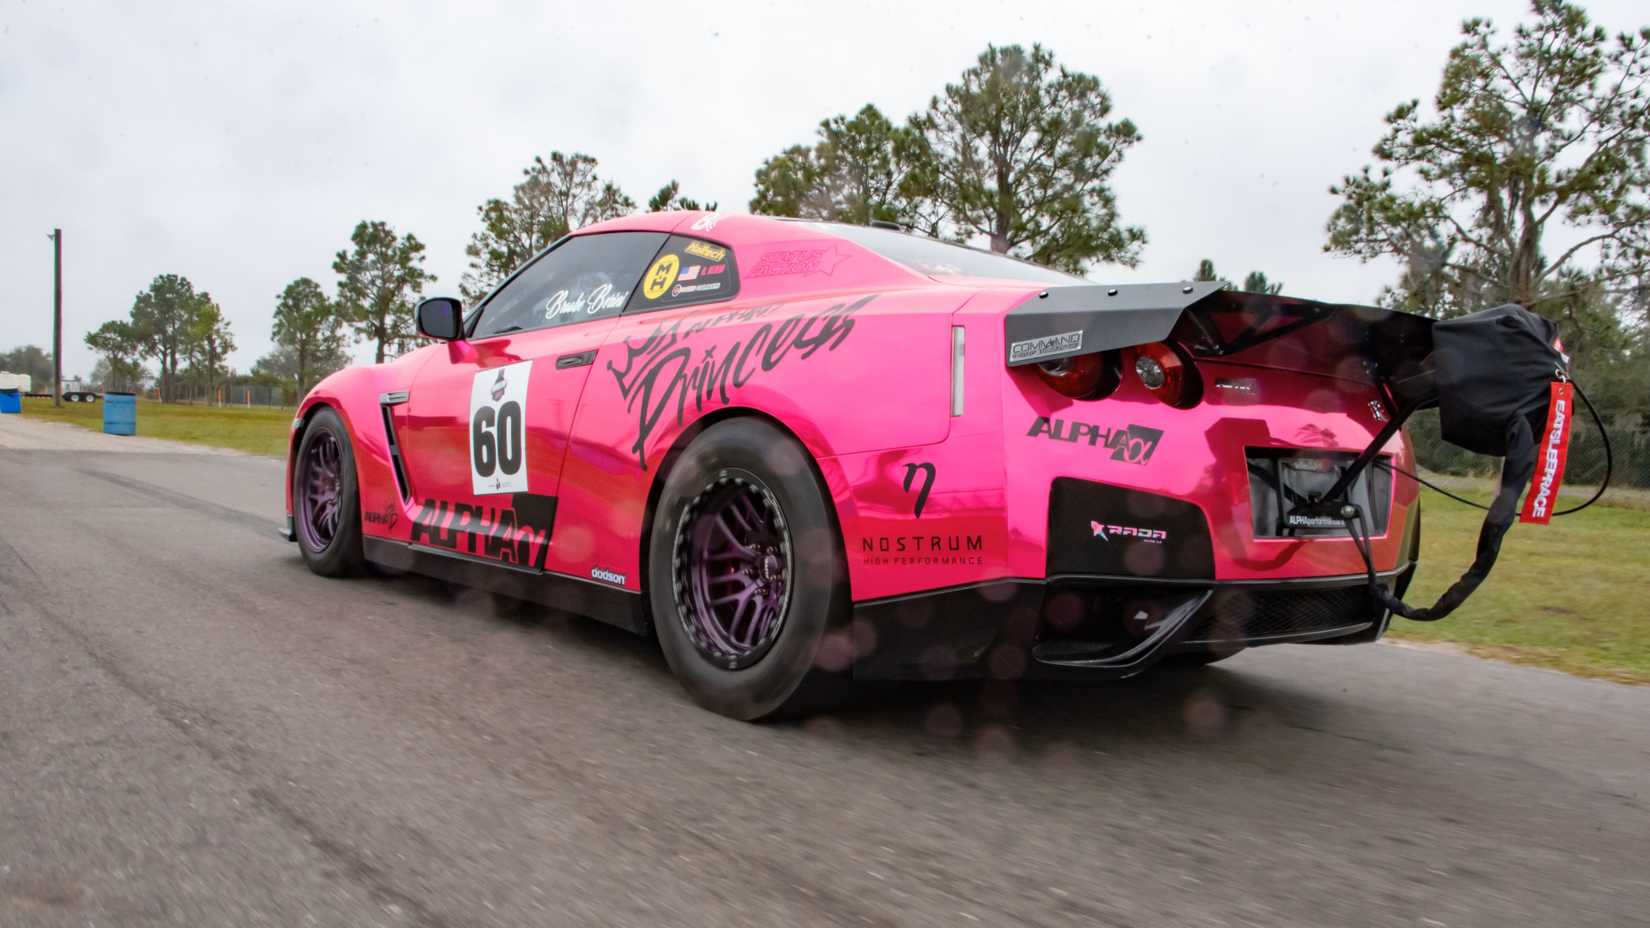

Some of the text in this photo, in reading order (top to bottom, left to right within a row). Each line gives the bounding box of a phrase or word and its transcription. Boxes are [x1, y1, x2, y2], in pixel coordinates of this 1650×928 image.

[1012, 333, 1080, 355] COMMAND
[473, 400, 522, 477] 60
[862, 535, 984, 552] NOSTRUM
[863, 556, 984, 566] HIGH PERFORMANCE
[591, 569, 626, 585] dodson
